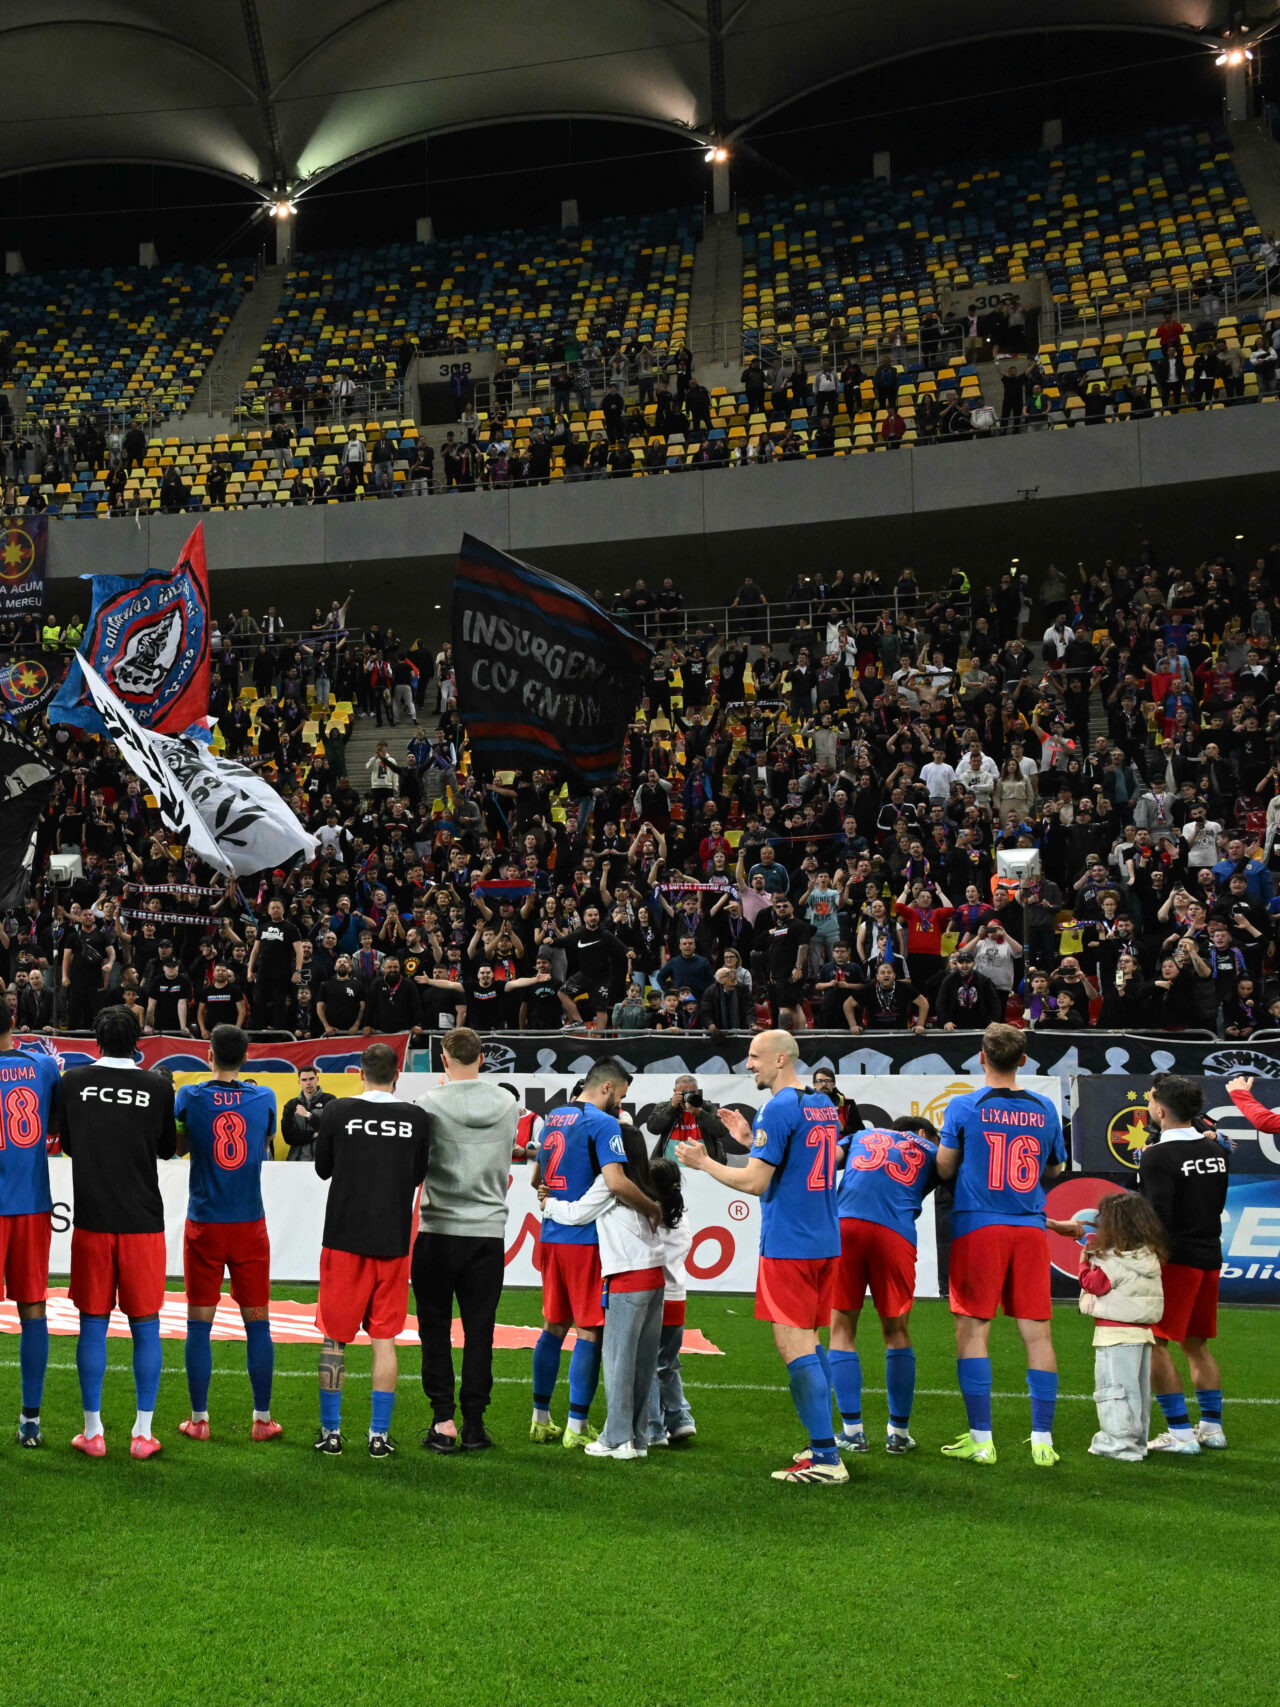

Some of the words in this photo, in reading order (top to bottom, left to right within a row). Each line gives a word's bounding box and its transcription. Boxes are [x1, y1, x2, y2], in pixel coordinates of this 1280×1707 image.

[440, 362, 472, 376] 308
[10, 581, 42, 594] ACUM
[6, 597, 42, 608] MEREU
[80, 1086, 150, 1108] FCSB
[214, 1091, 243, 1106] SUT
[545, 1113, 578, 1128] CRETU
[981, 1107, 1046, 1128] LIXANDRU
[345, 1119, 413, 1138] FCSB
[212, 1111, 247, 1170] 8
[543, 1131, 568, 1190] 2
[806, 1124, 837, 1191] 21
[852, 1133, 926, 1186] 33
[983, 1131, 1041, 1192] 16
[1181, 1157, 1227, 1176] FCSB
